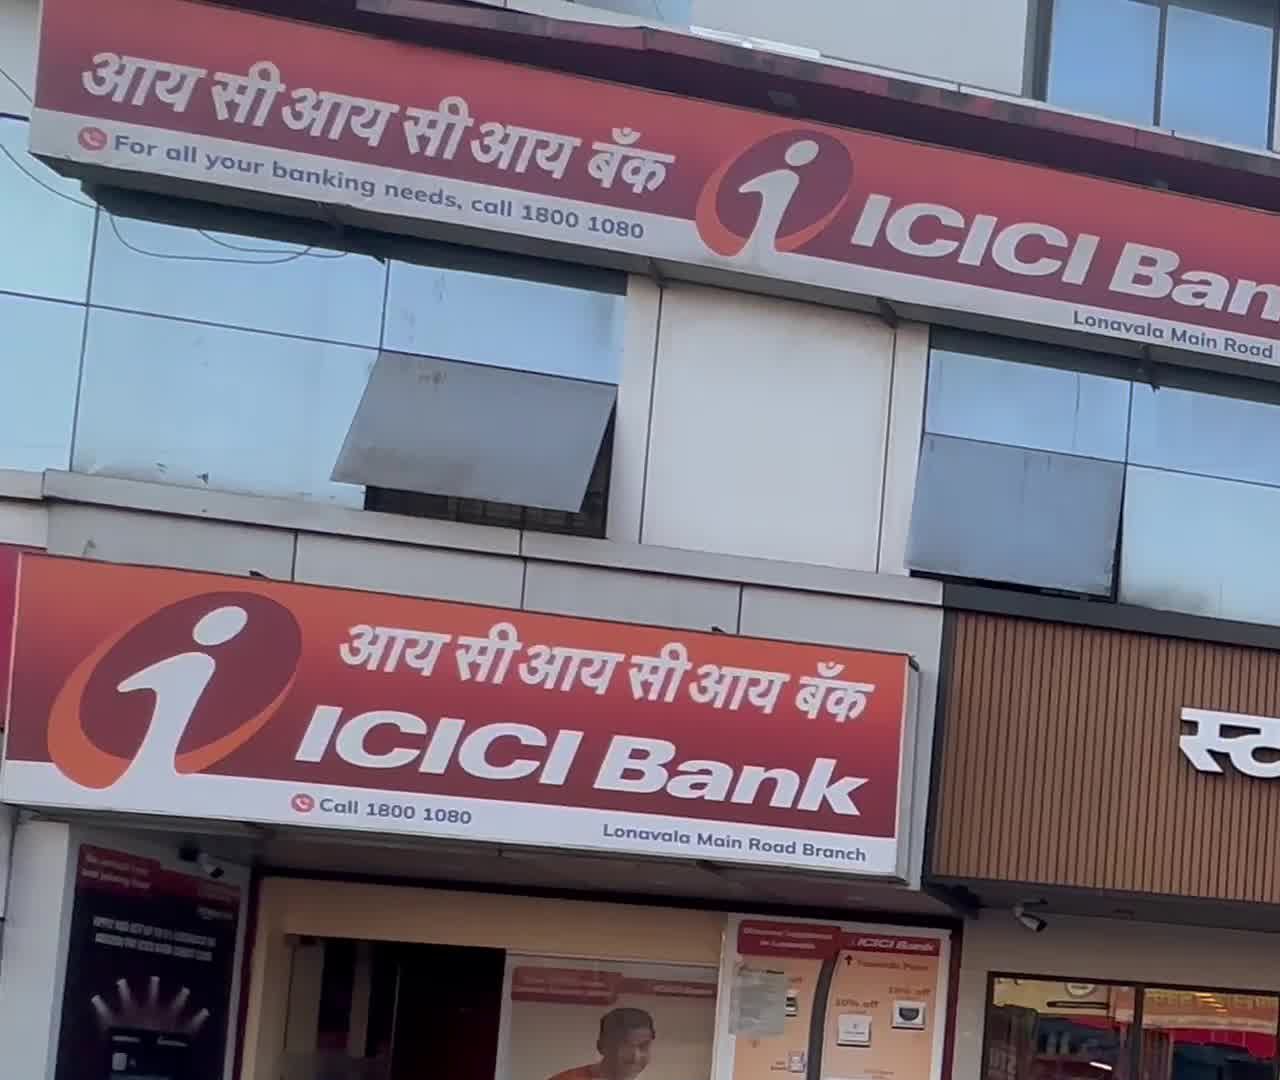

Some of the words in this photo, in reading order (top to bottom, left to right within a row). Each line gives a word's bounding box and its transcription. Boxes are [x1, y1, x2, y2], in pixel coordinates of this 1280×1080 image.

[82, 52, 206, 112] आय
[211, 61, 280, 127] सी
[281, 87, 398, 147] आय
[403, 96, 474, 160] सी
[471, 122, 581, 178] आय
[588, 128, 674, 194] बँक
[114, 135, 158, 159] For
[166, 139, 198, 163] all
[205, 147, 265, 178] your
[272, 160, 376, 199] banking
[384, 183, 463, 211] needs,
[471, 195, 512, 218] call
[522, 205, 580, 229] 1800
[588, 216, 644, 239] 1080
[851, 194, 1099, 285] ICICI
[1073, 310, 1163, 339] Lonavala
[1170, 326, 1217, 349] Main
[1223, 336, 1273, 360] Road
[339, 624, 452, 677] आय
[456, 622, 520, 684] सी
[519, 641, 625, 694] आय
[628, 641, 690, 702] सी
[688, 660, 788, 713] आय
[793, 662, 874, 723] बँक
[295, 705, 584, 786] ICICI
[594, 735, 870, 816] Bank
[319, 797, 358, 818] Call
[366, 801, 416, 821] 1800
[422, 806, 472, 825] 1080
[602, 823, 690, 846] Lonavala
[697, 831, 743, 850] Main
[749, 837, 796, 855] Road
[802, 840, 867, 863] Branch
